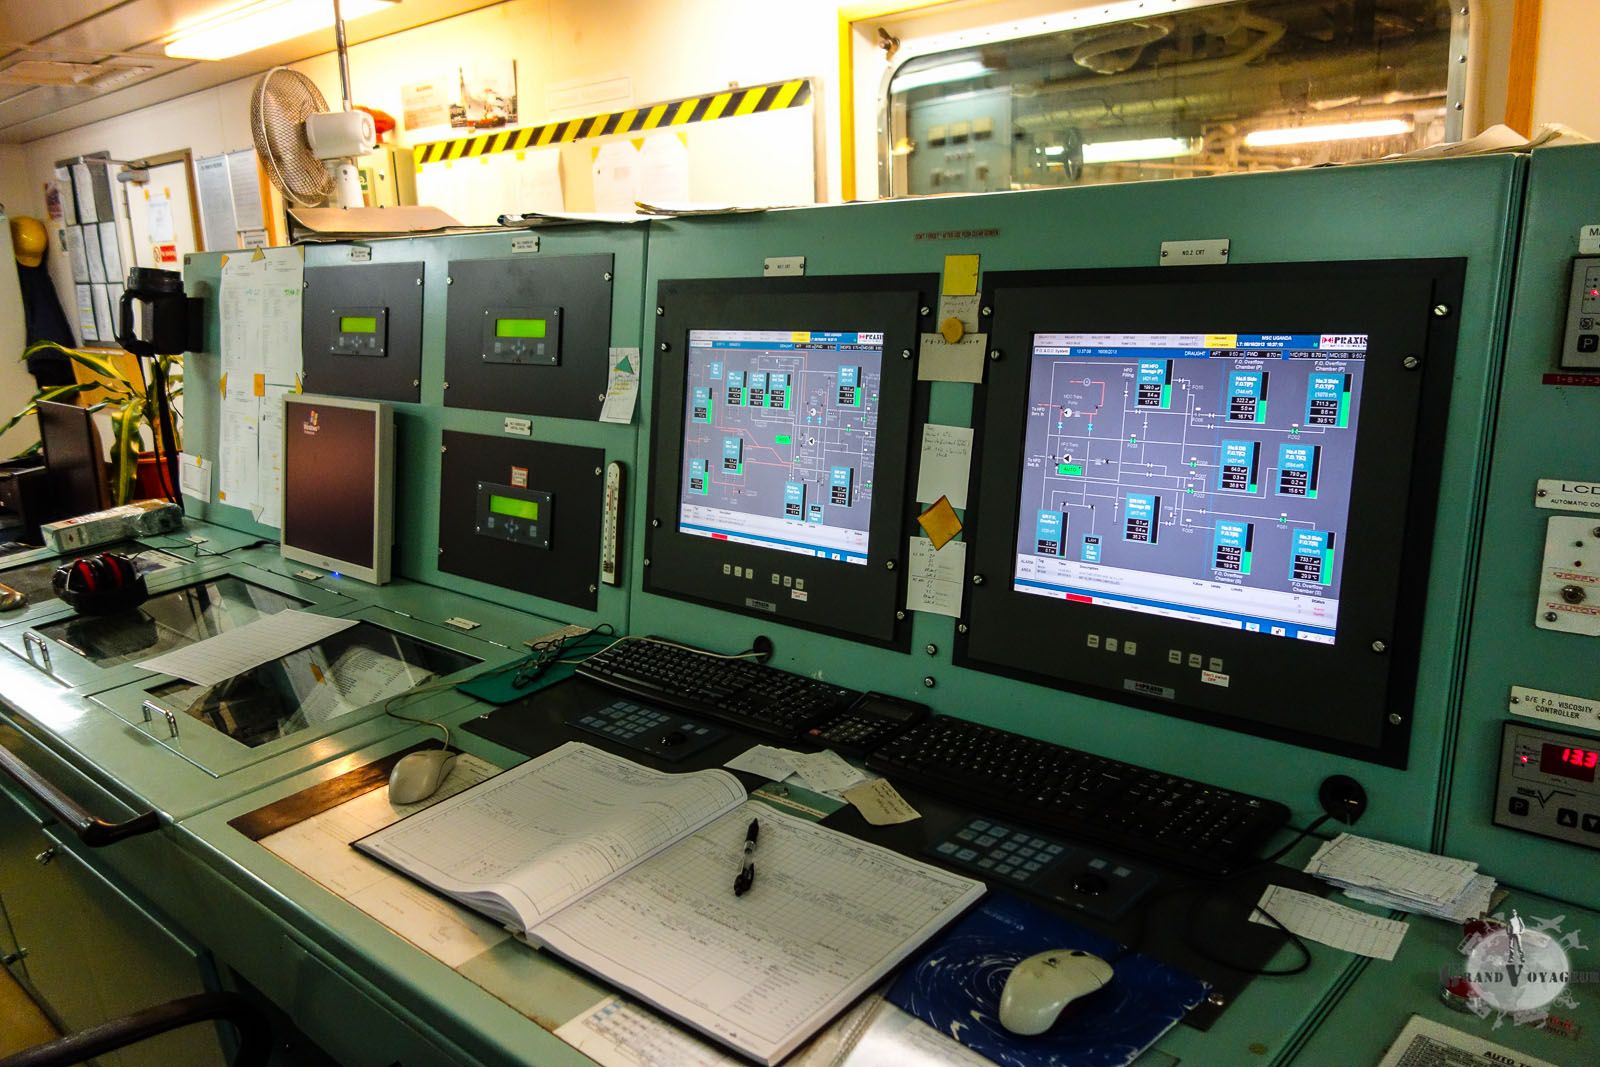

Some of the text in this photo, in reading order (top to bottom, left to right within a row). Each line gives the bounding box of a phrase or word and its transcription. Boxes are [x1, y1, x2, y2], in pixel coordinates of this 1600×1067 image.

[1336, 336, 1368, 344] PRAXIS
[1551, 499, 1588, 507] AUTOMATIC
[1302, 582, 1323, 590] Overflow
[1542, 698, 1553, 706] F.O.
[1558, 702, 1593, 713] VISCOSITY
[1536, 705, 1580, 719] CONTROLLER
[1484, 1050, 1515, 1064] AUTO
